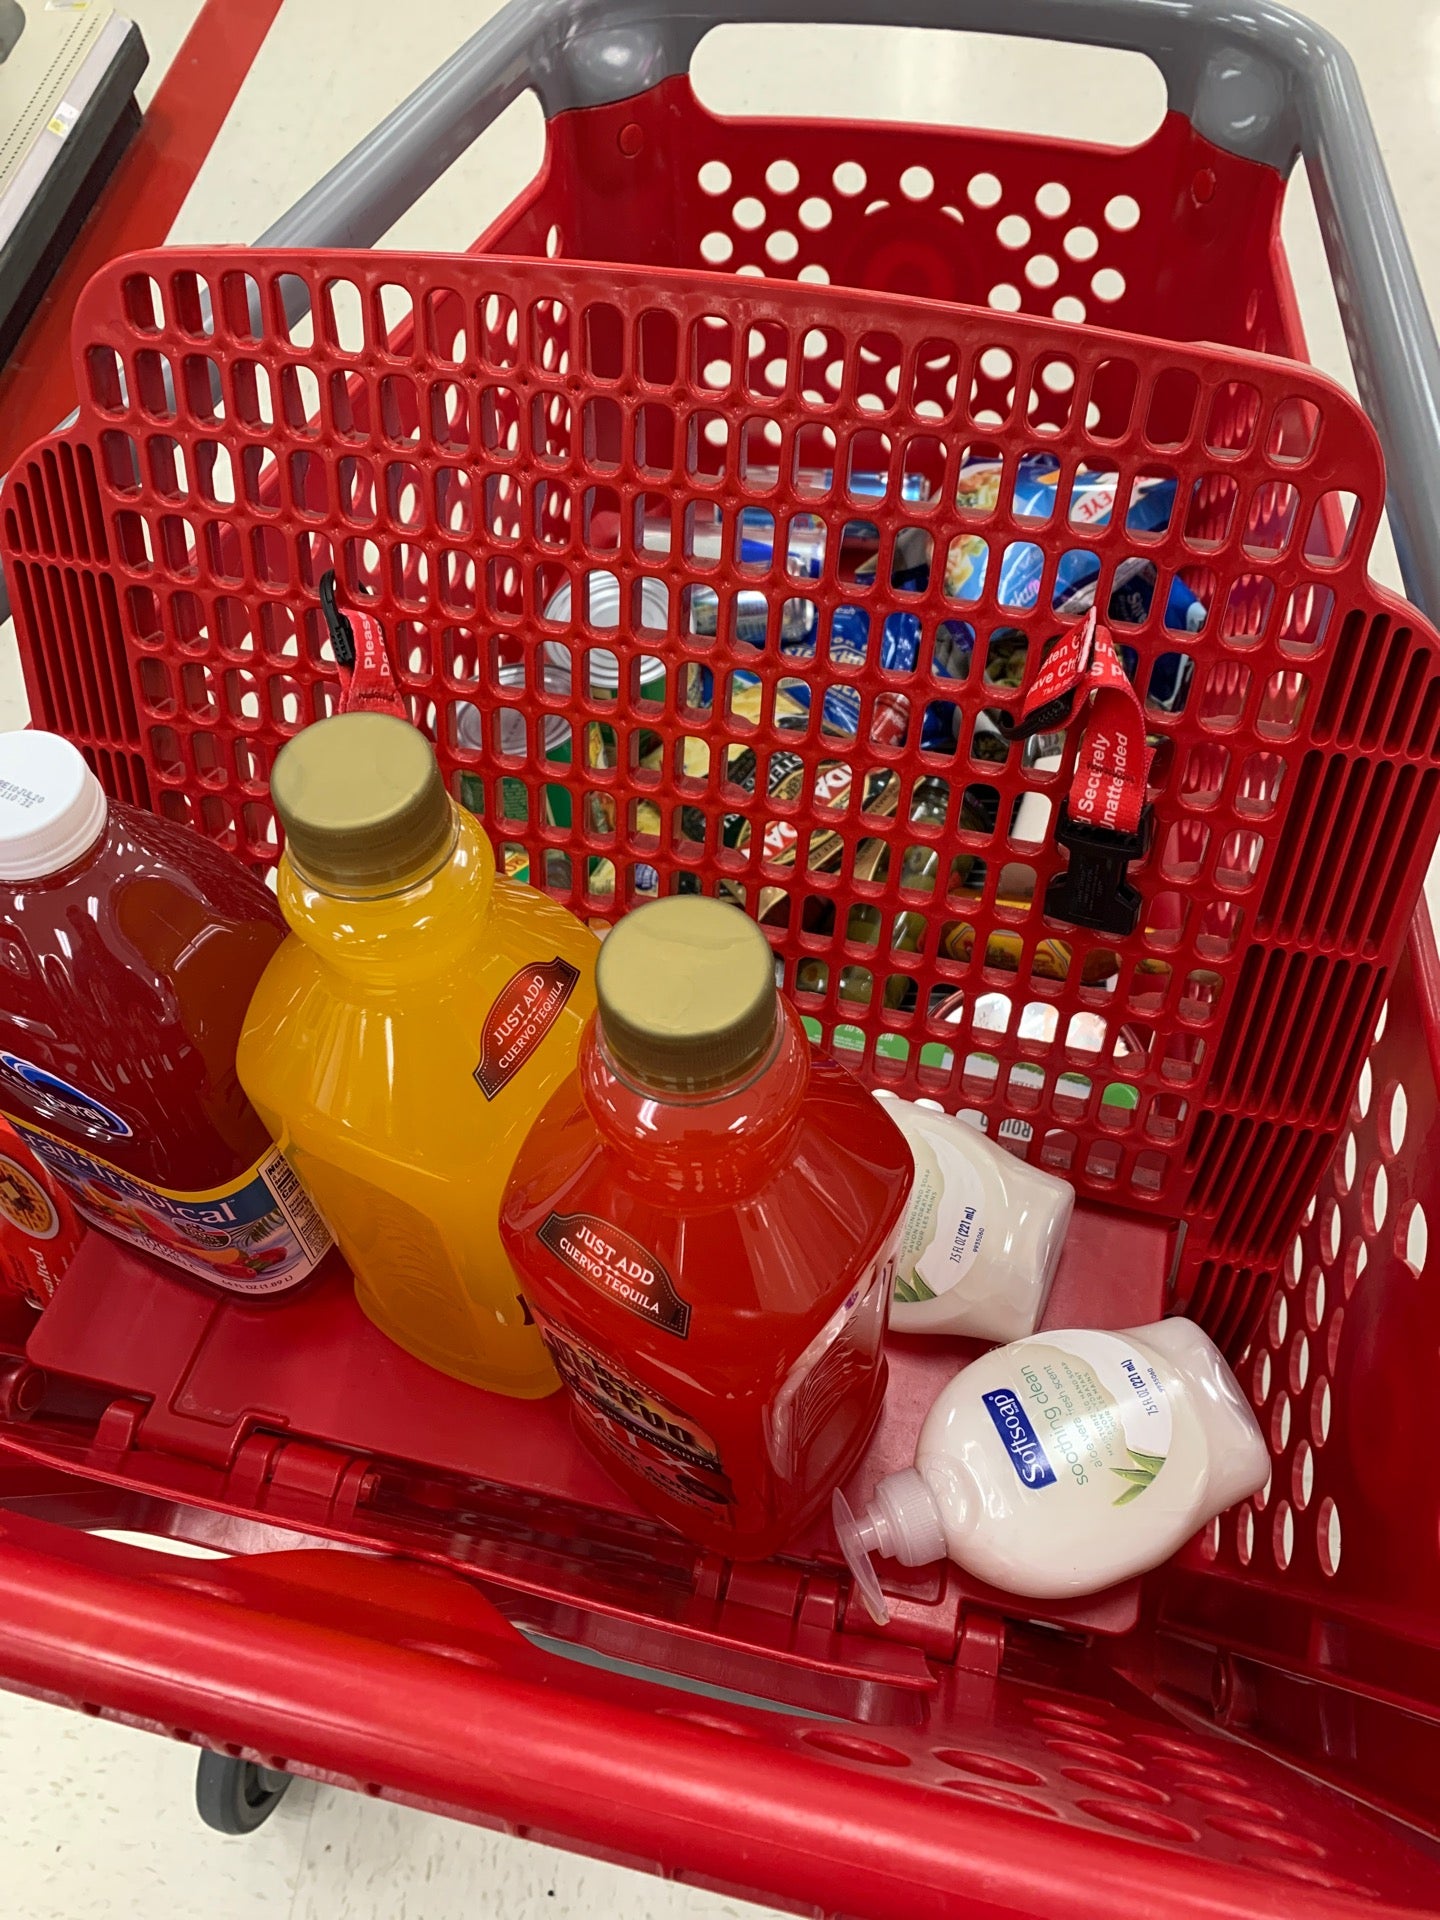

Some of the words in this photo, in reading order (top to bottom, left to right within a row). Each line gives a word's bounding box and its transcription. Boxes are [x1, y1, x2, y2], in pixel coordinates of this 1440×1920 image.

[1078, 490, 1114, 522] EYE
[1077, 733, 1112, 813] Securely
[1102, 731, 1129, 831] Unattended
[493, 1004, 525, 1045] JUST
[523, 975, 545, 1009] ADD
[498, 1024, 537, 1069] CUERVO
[533, 981, 564, 1025] TEQUILA
[913, 1189, 923, 1211] HAND
[962, 1206, 976, 1221] mL)
[954, 1236, 966, 1246] OZ
[957, 1220, 972, 1238] (221
[576, 1225, 616, 1261] JUST
[615, 1256, 655, 1286] ADD
[560, 1237, 603, 1278] CUERVO
[603, 1272, 660, 1314] TEQUILA
[1043, 1363, 1063, 1392] scent
[1061, 1360, 1075, 1380] SOAP
[1120, 1358, 1136, 1374] mL)
[1128, 1370, 1146, 1391] (221
[1020, 1364, 1049, 1405] clean
[994, 1393, 1045, 1484] Softsoap
[1044, 1404, 1089, 1486] soothing
